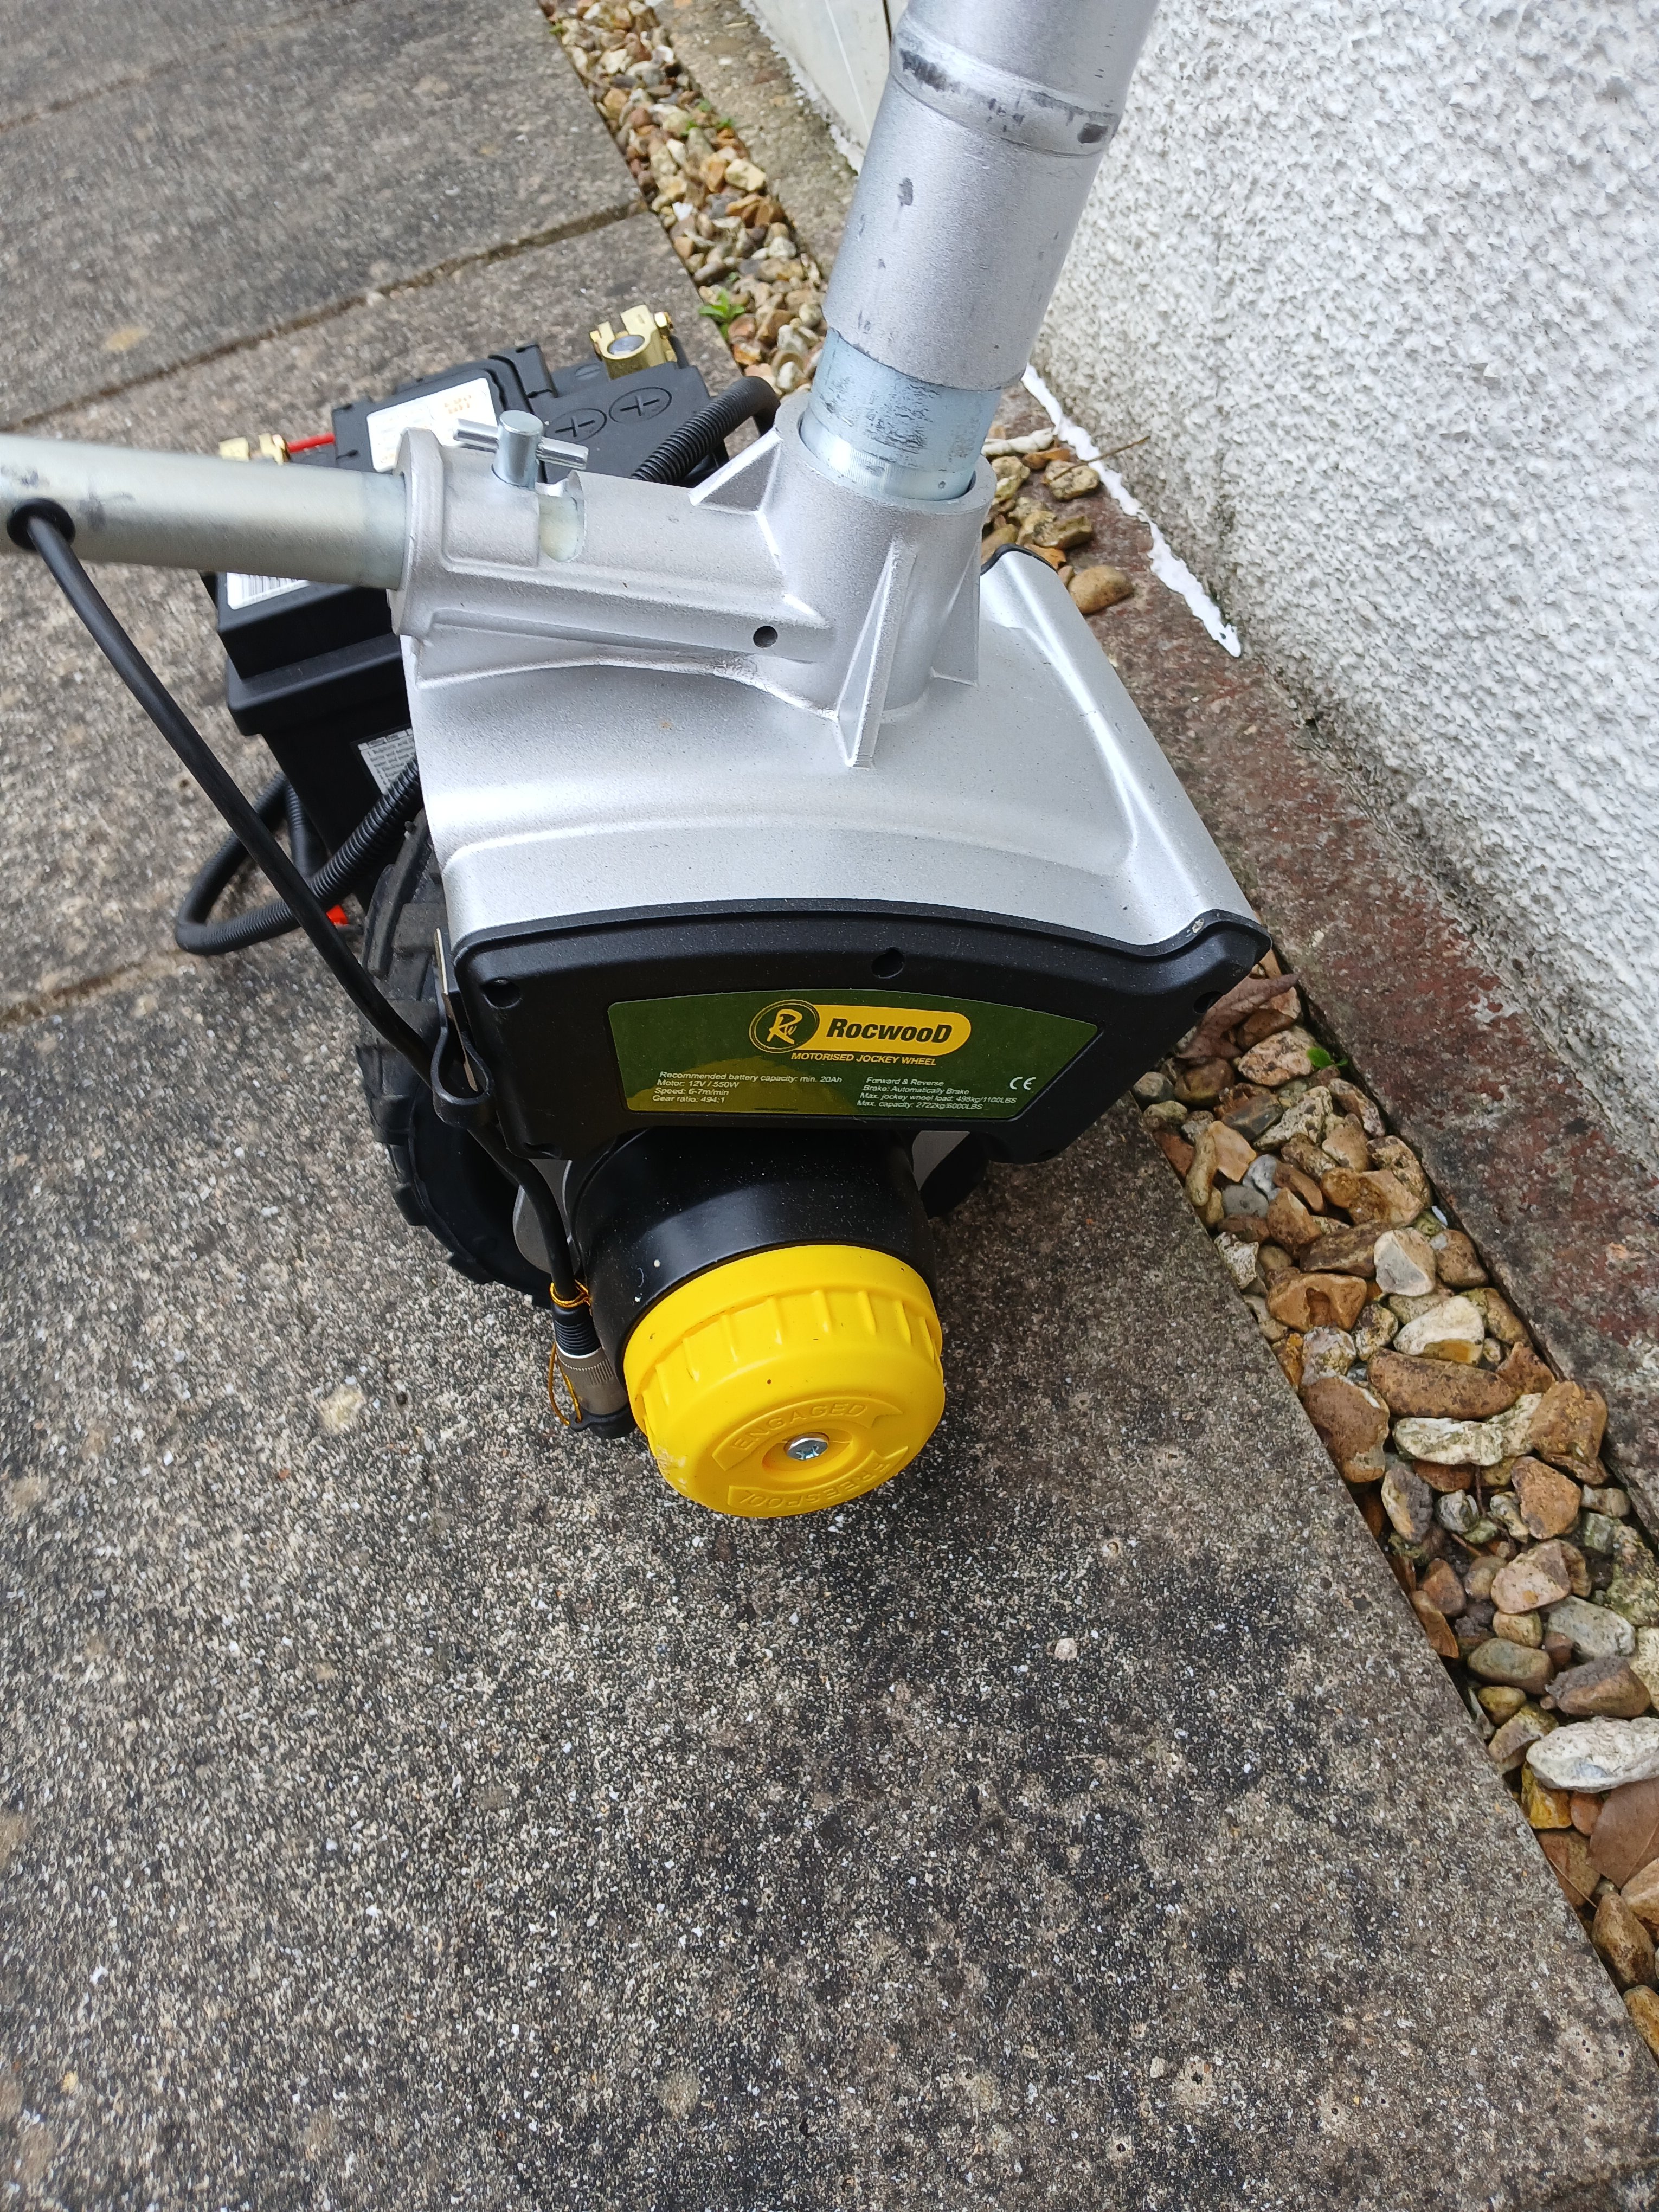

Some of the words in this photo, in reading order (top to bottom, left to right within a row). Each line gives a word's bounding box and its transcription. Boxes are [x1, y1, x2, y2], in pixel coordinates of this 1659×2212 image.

[790, 1052, 854, 1062] MOTORISED
[856, 1054, 899, 1064] JOCKEY
[901, 1056, 937, 1066] WHEEL
[659, 1071, 726, 1080] Recommended
[728, 1075, 758, 1083] battery
[760, 1075, 799, 1083] capacity:
[866, 1077, 901, 1085] Forward
[654, 1087, 686, 1095] Speed:
[890, 1085, 946, 1095] Automatically
[732, 1403, 867, 1450] ENGAGED
[740, 1463, 890, 1509] FREESPOOL
